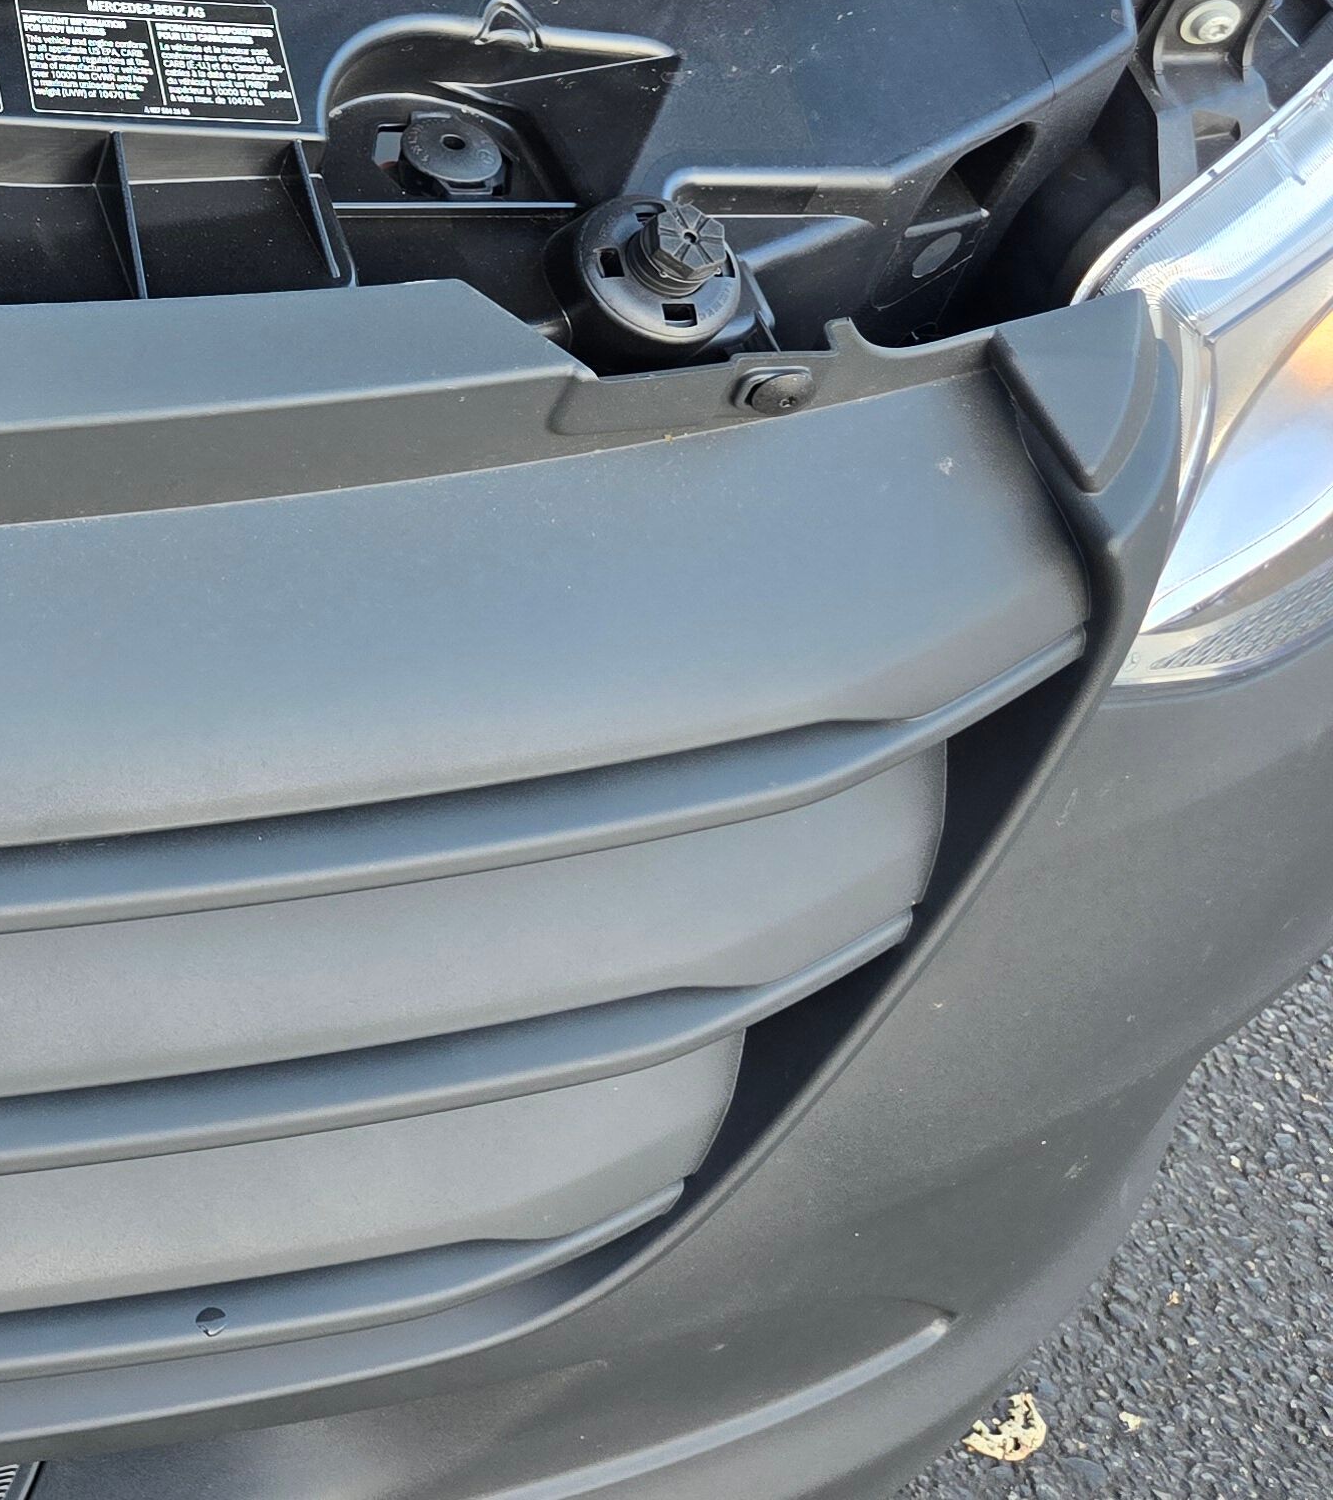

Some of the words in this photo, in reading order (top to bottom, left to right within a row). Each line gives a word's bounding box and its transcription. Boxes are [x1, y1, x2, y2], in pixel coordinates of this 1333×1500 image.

[86, 0, 186, 17] MERCEDES-BENZ
[187, 6, 206, 18] AG
[22, 14, 69, 25] IMPORTANT
[25, 34, 42, 43] This
[51, 71, 76, 80] 10000
